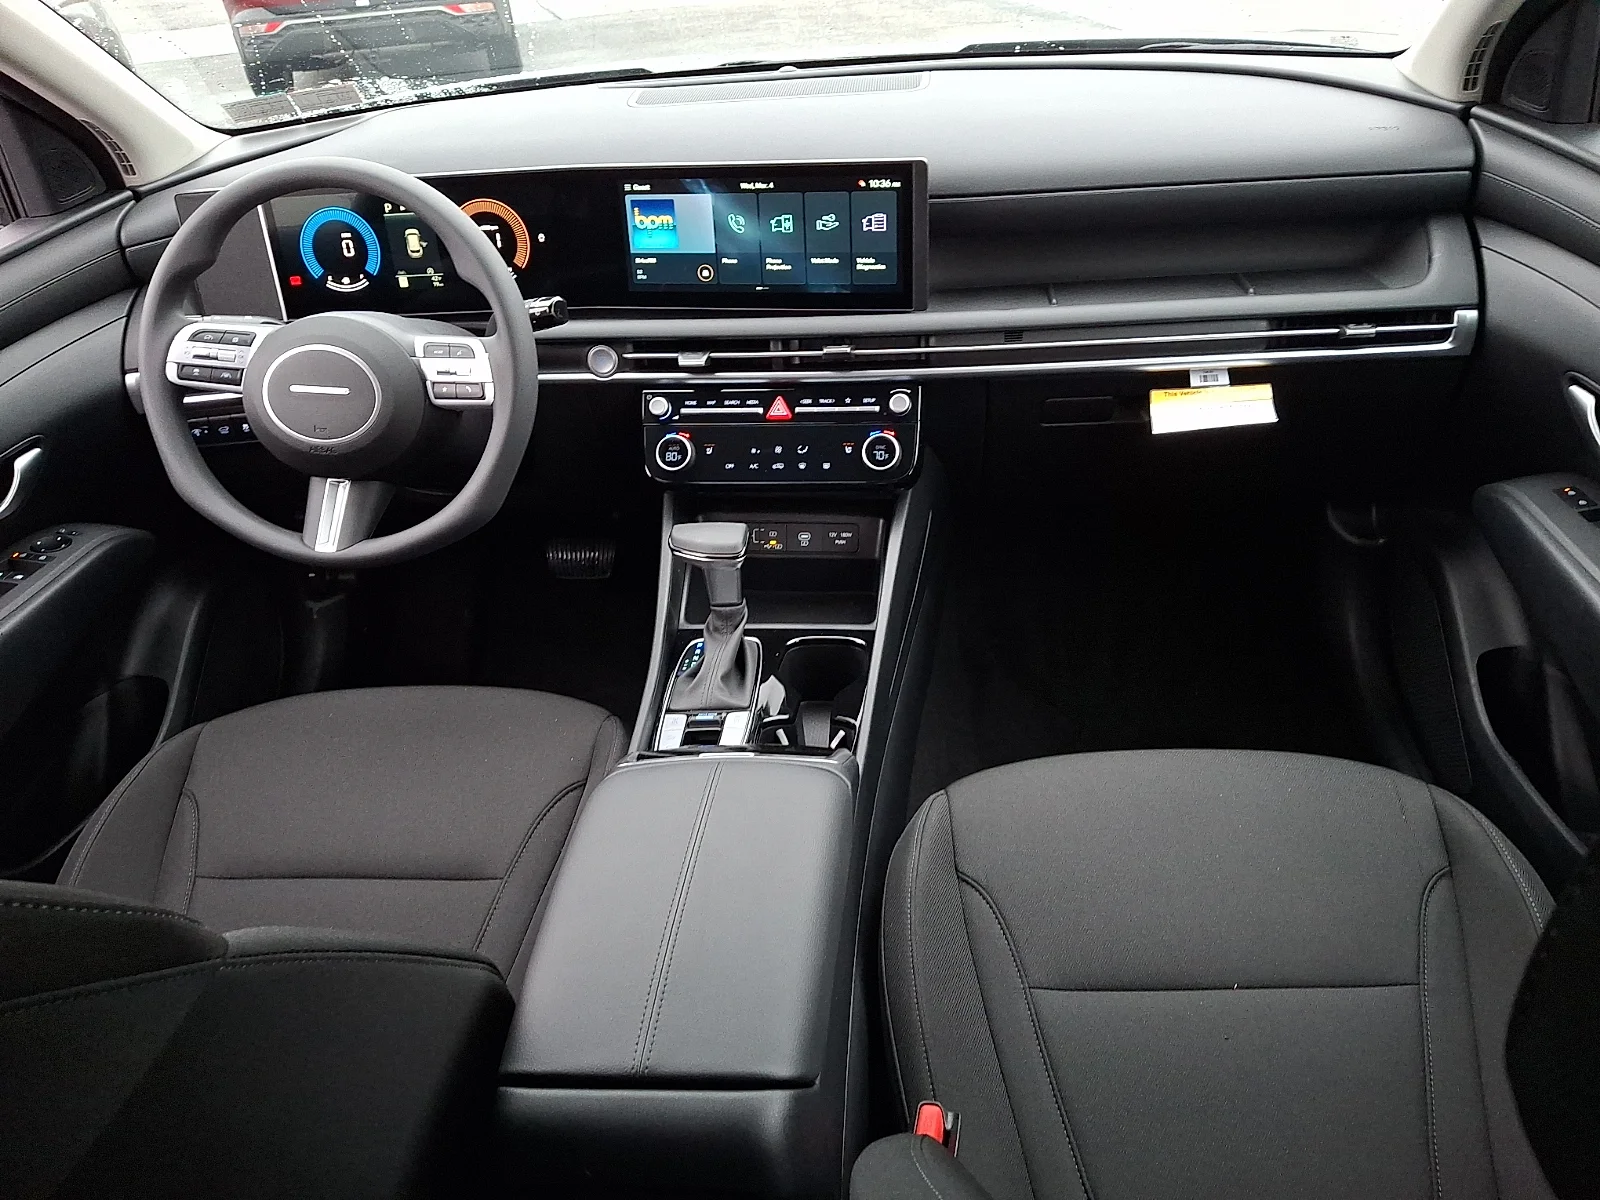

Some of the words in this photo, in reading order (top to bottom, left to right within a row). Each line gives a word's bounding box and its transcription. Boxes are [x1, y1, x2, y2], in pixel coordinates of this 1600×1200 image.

[868, 179, 891, 188] 10:36
[384, 203, 392, 213] P
[633, 207, 674, 238] bpm
[341, 239, 355, 257] 0
